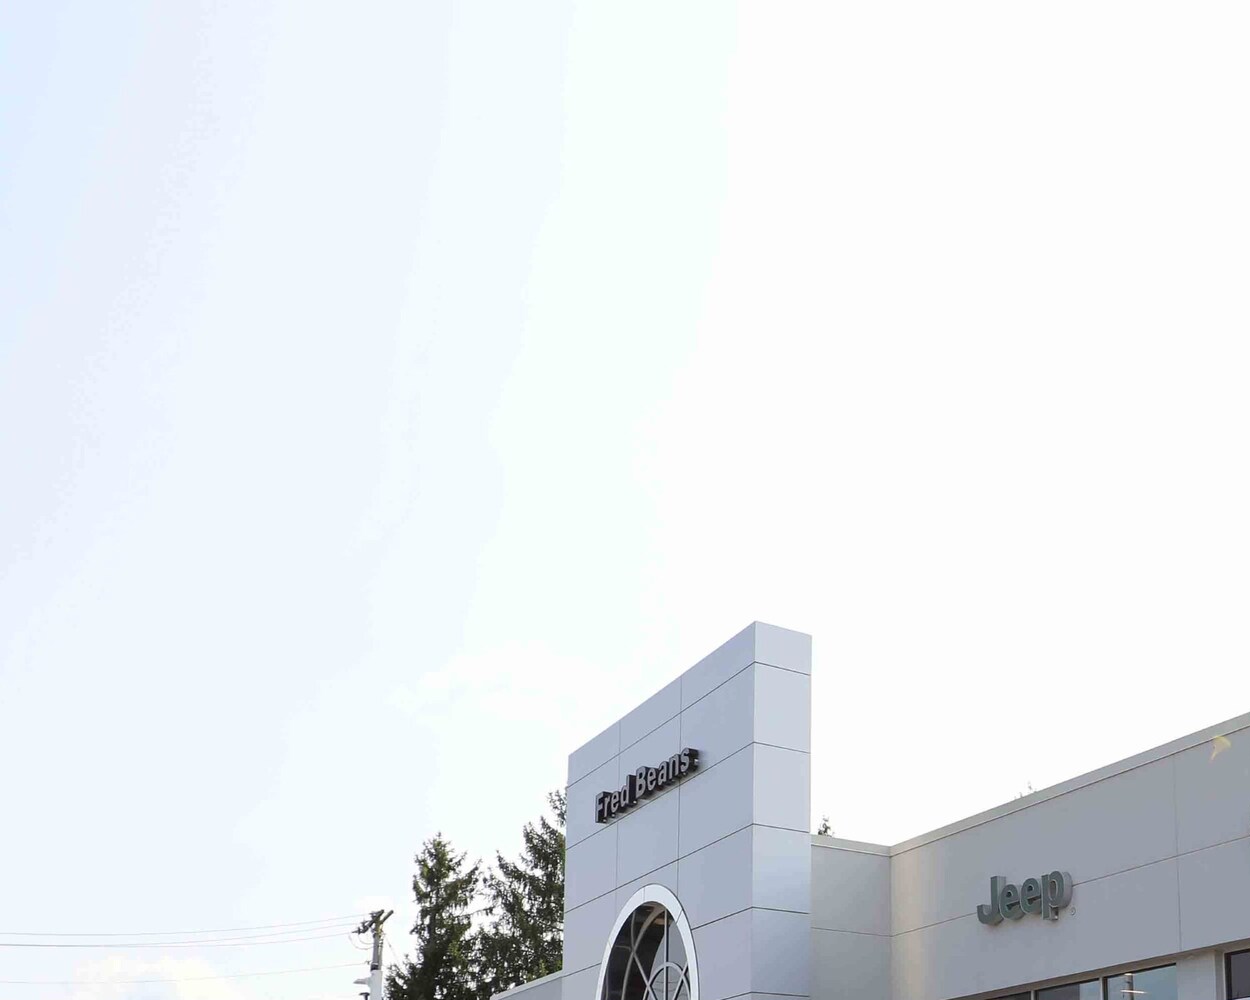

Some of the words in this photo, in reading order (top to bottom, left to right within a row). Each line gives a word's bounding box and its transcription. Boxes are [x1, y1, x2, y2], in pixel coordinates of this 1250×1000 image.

[595, 772, 635, 824] Fred
[636, 747, 698, 800] Beans
[977, 870, 1072, 925] Jeep
